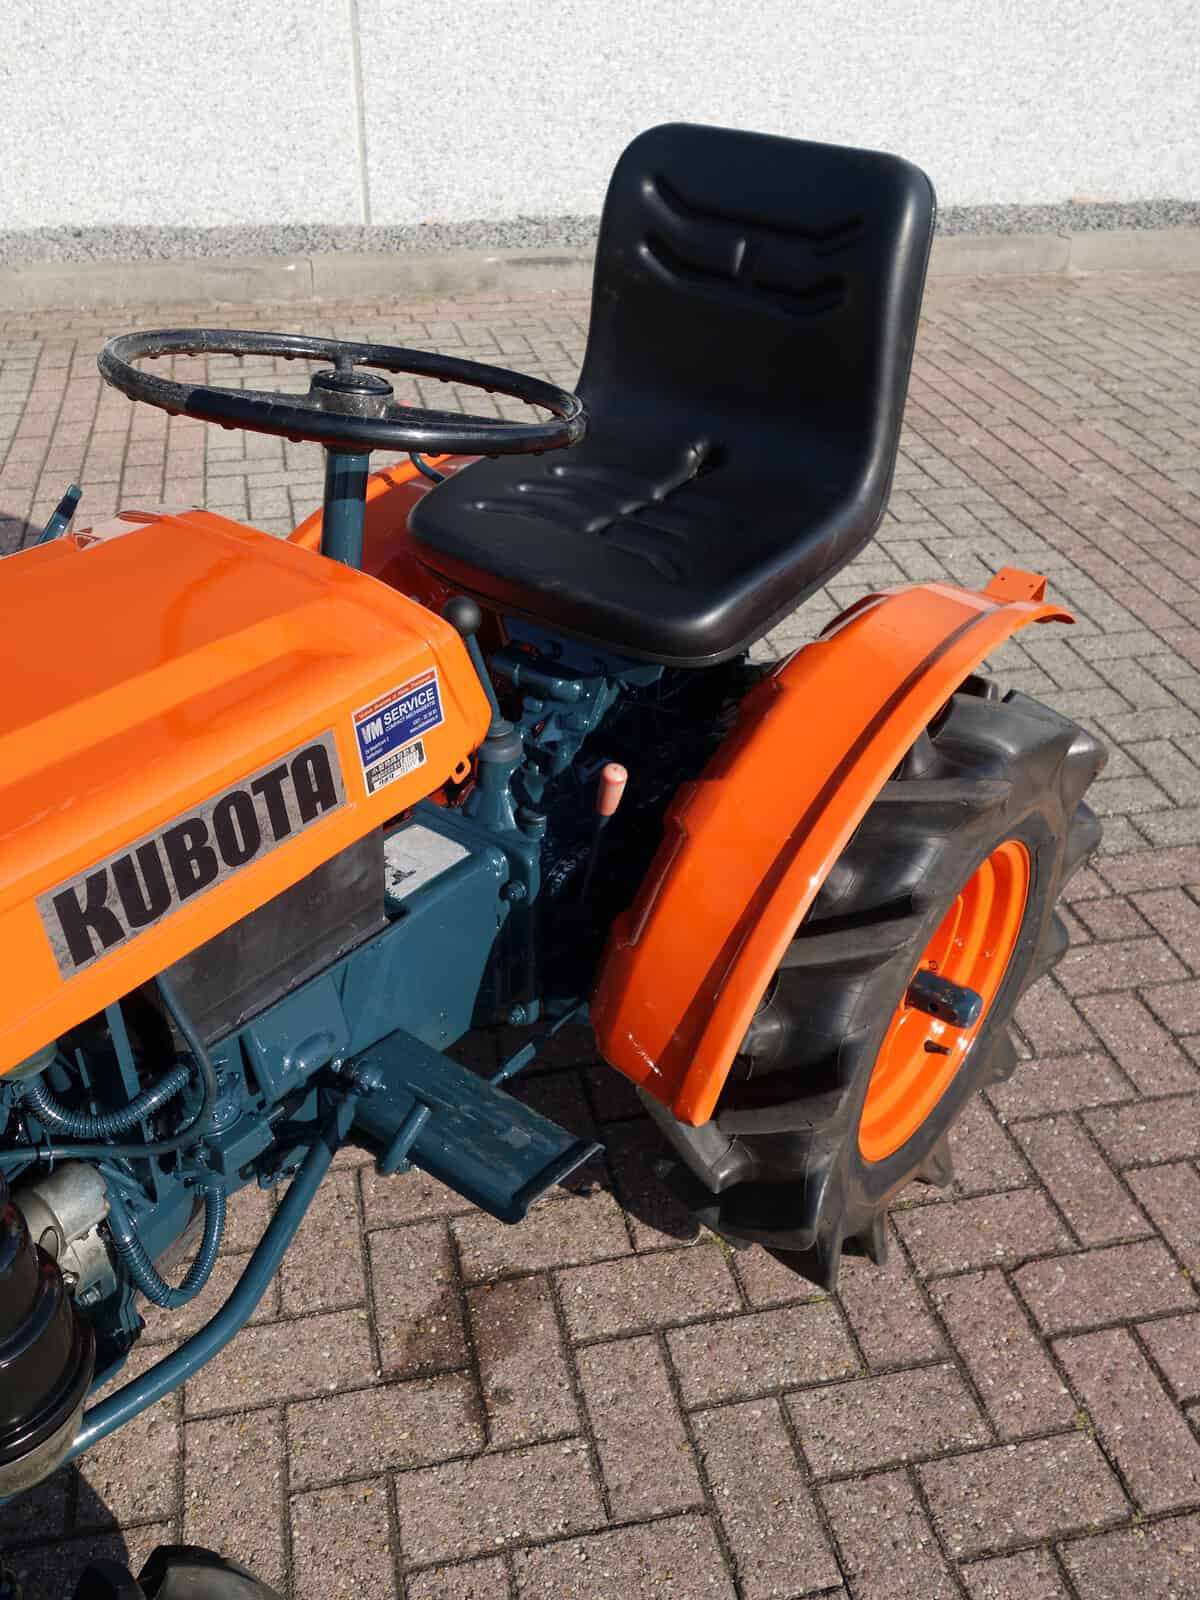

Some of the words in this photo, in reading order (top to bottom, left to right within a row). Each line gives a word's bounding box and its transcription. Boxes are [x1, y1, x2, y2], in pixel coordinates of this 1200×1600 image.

[361, 717, 384, 745] VM
[383, 687, 435, 726] SERVICE
[52, 744, 338, 967] KUBOTA
